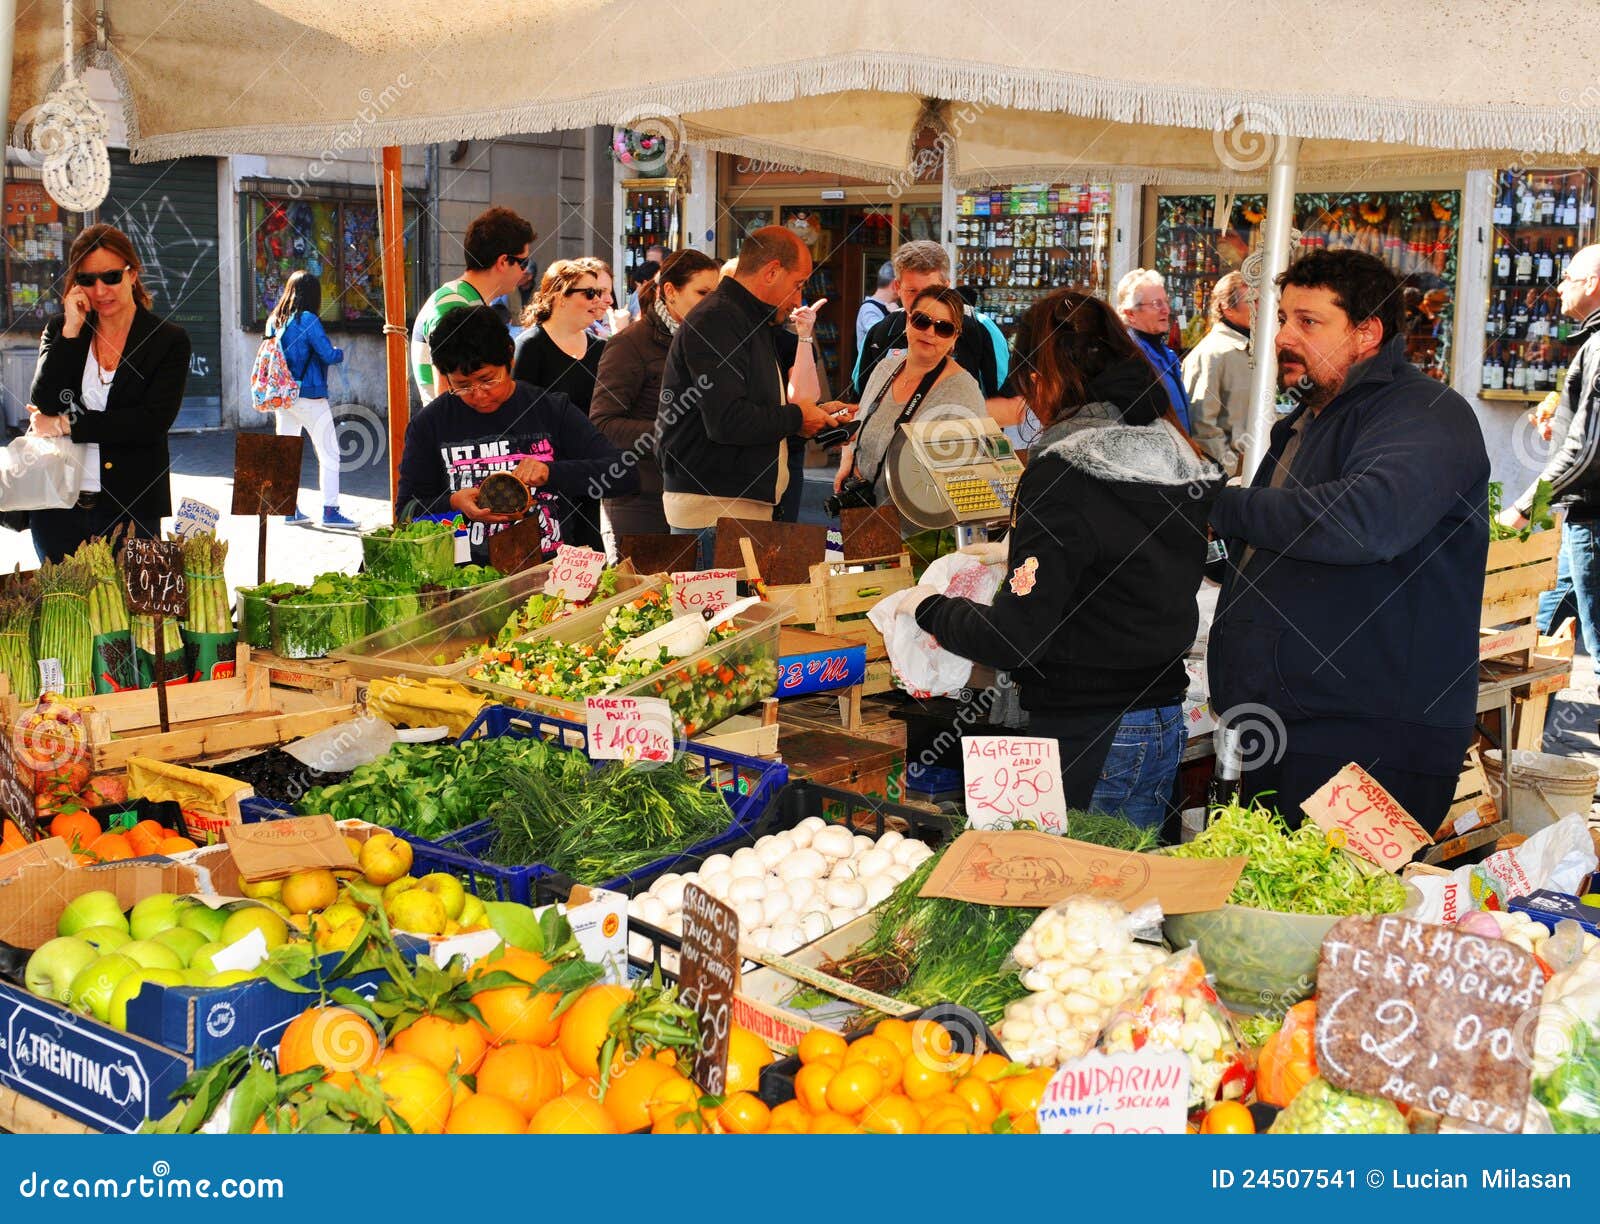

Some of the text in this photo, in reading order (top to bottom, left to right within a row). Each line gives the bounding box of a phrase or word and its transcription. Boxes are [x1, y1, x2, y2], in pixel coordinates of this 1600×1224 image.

[560, 556, 589, 568] MISTA
[587, 698, 638, 711] AGRETTI
[967, 739, 1050, 760] AGRETTI
[682, 914, 722, 957] TAVOLA
[1376, 917, 1547, 996] FRAGOLE
[1322, 940, 1537, 1010] TERRACINA
[29, 1032, 113, 1100] TRENTINA
[1114, 1095, 1171, 1110] SICILIA
